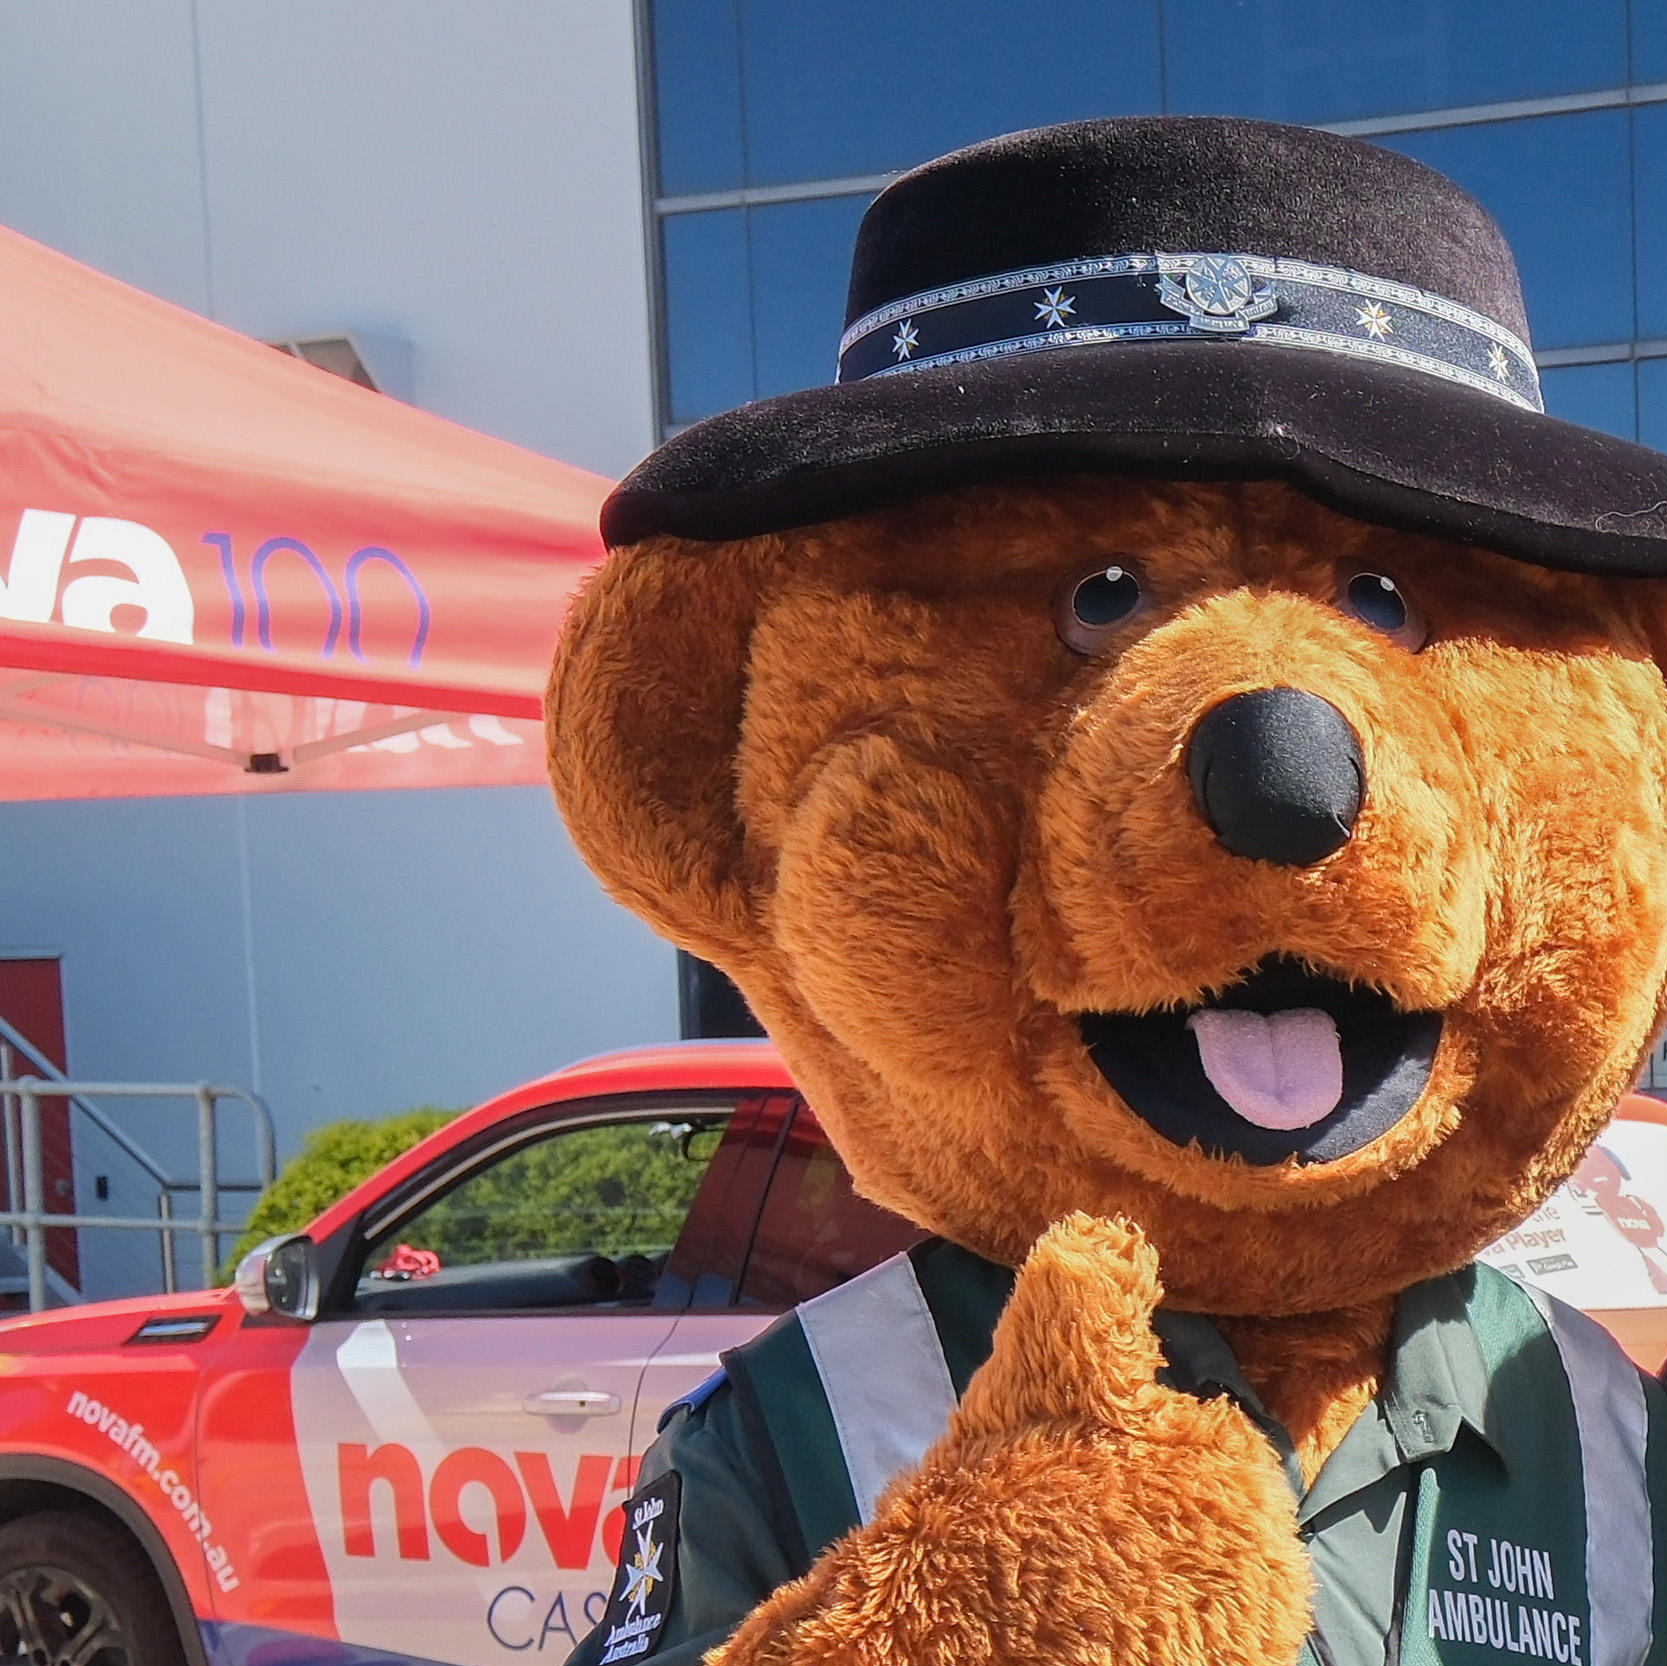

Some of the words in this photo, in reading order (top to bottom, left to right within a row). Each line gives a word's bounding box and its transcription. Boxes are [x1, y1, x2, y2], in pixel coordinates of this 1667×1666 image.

[1505, 1228, 1566, 1250] Player
[66, 1390, 240, 1593] novafm.com.au
[1447, 1529, 1478, 1583] ST
[1487, 1538, 1555, 1600] JOHN
